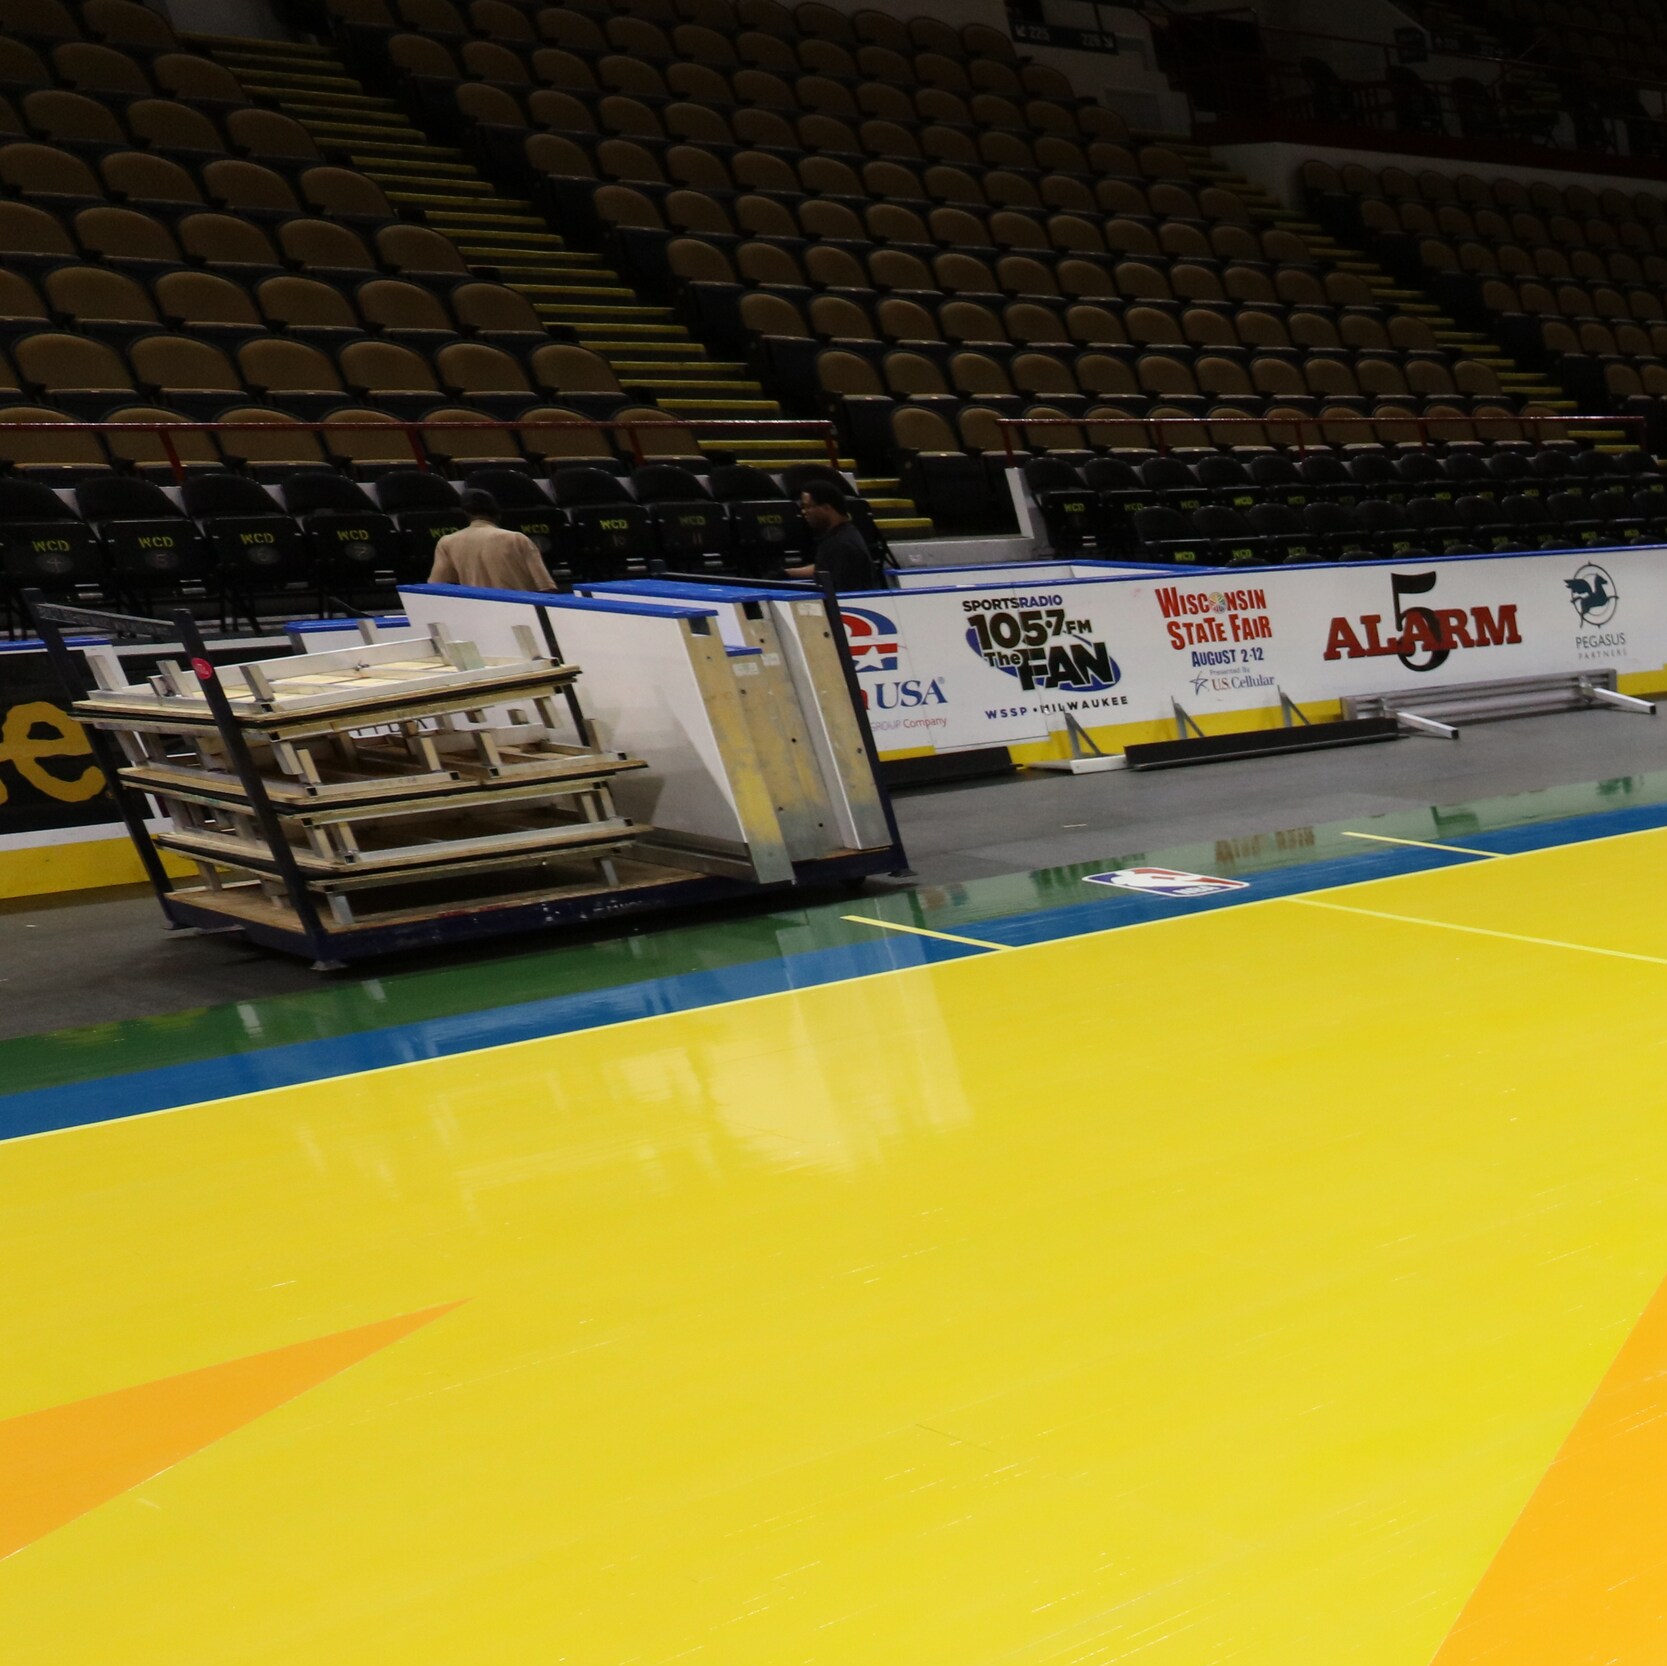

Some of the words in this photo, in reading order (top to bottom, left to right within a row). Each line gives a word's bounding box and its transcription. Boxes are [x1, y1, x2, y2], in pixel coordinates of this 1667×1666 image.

[600, 519, 628, 530] WCD
[679, 516, 706, 527] WCD
[757, 514, 783, 525] WCD
[337, 529, 369, 541] WCD
[521, 523, 550, 534] WCD
[32, 540, 71, 552] WCD
[138, 536, 175, 549] WCD
[240, 533, 276, 545] WCD
[962, 595, 1063, 613] SPORTSRADIO
[1065, 619, 1093, 635] FM
[1391, 571, 1451, 673] 5
[1166, 617, 1228, 650] STATE
[1228, 613, 1273, 642] FAIR
[1323, 604, 1522, 661] ALARM
[1575, 632, 1627, 649] PEGASUS
[1191, 649, 1237, 667] AUGUST
[1577, 648, 1628, 659] PARTNERS
[984, 651, 1021, 667] The
[1017, 642, 1115, 691] FAN
[1231, 674, 1276, 689] Cellular
[874, 679, 948, 710] USA
[985, 707, 1028, 720] WSSP
[1040, 696, 1129, 714] MILWAUKEE
[903, 717, 947, 729] Company
[0, 701, 107, 803] e
